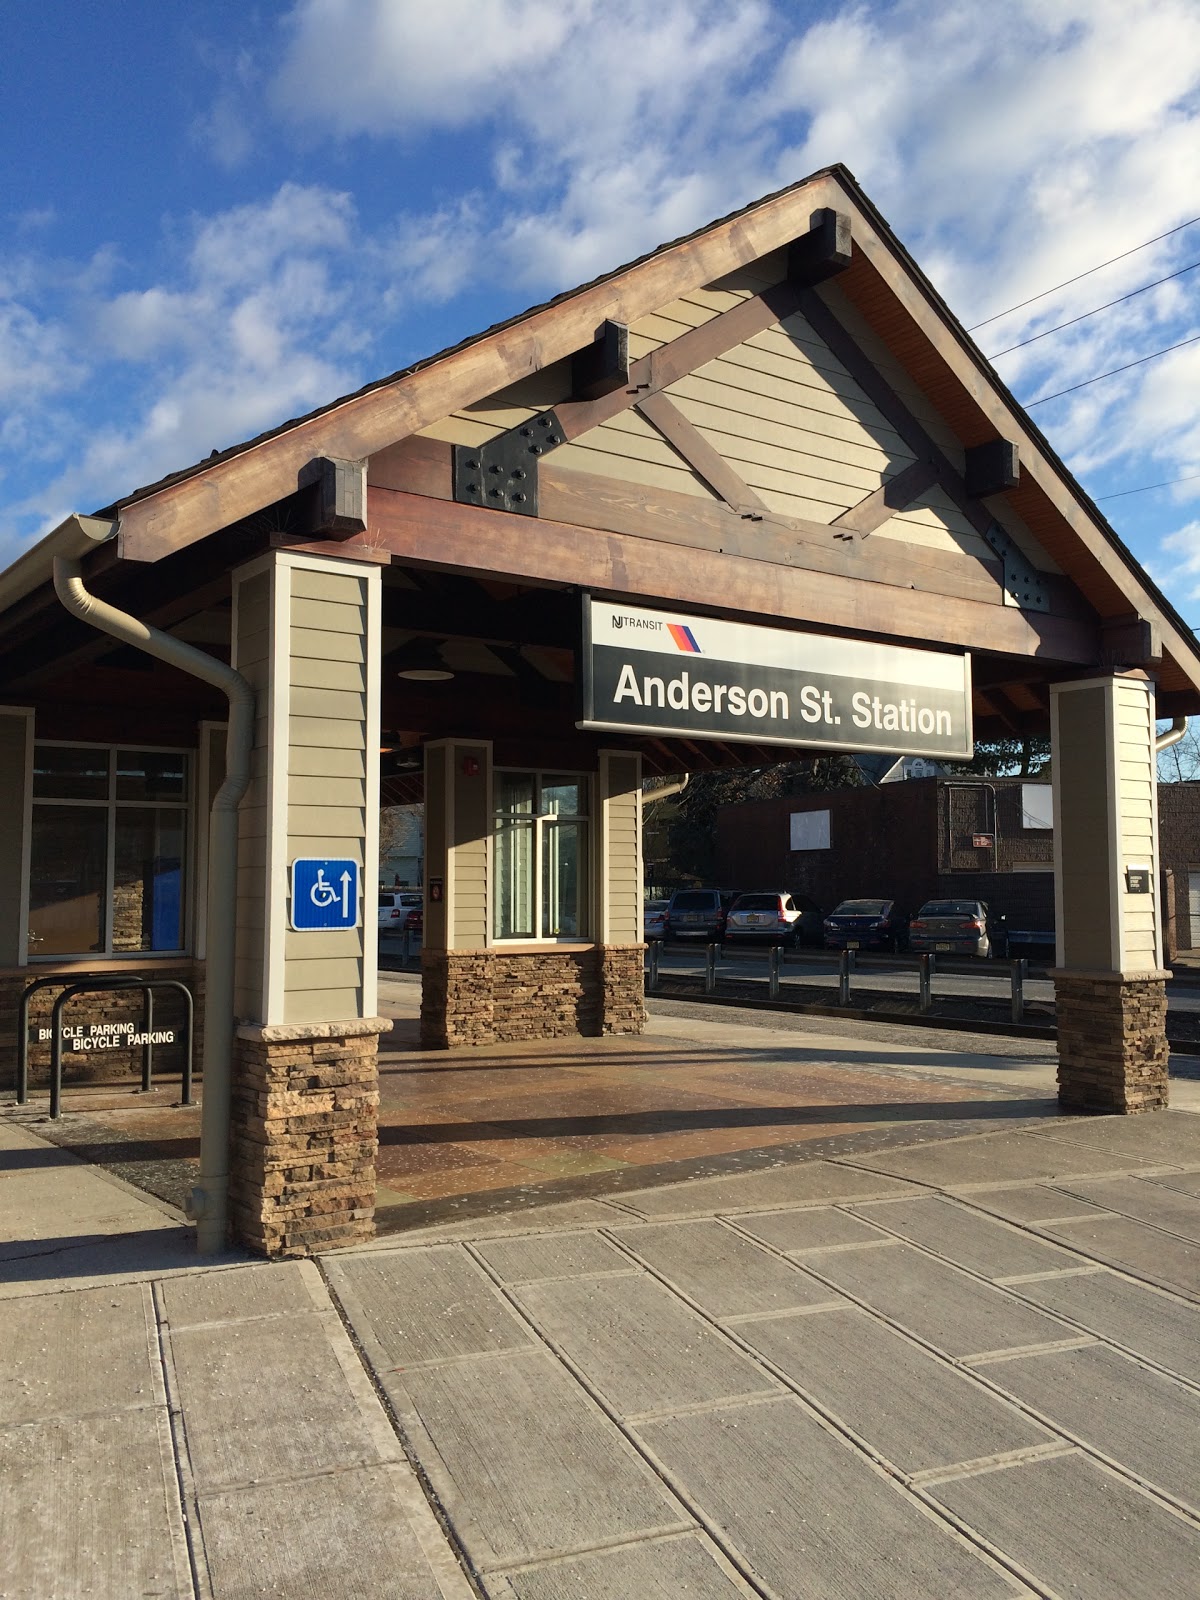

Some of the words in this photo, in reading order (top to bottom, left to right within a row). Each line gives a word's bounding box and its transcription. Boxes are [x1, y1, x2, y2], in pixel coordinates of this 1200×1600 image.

[624, 617, 663, 630] TRANSIT
[613, 664, 789, 720] Anderson
[800, 685, 841, 725] St.
[852, 691, 952, 736] Station
[39, 1026, 84, 1040] BICLE
[90, 1022, 134, 1036] PARKING
[73, 1035, 120, 1050] BICYCLE
[127, 1031, 174, 1046] PARKING
